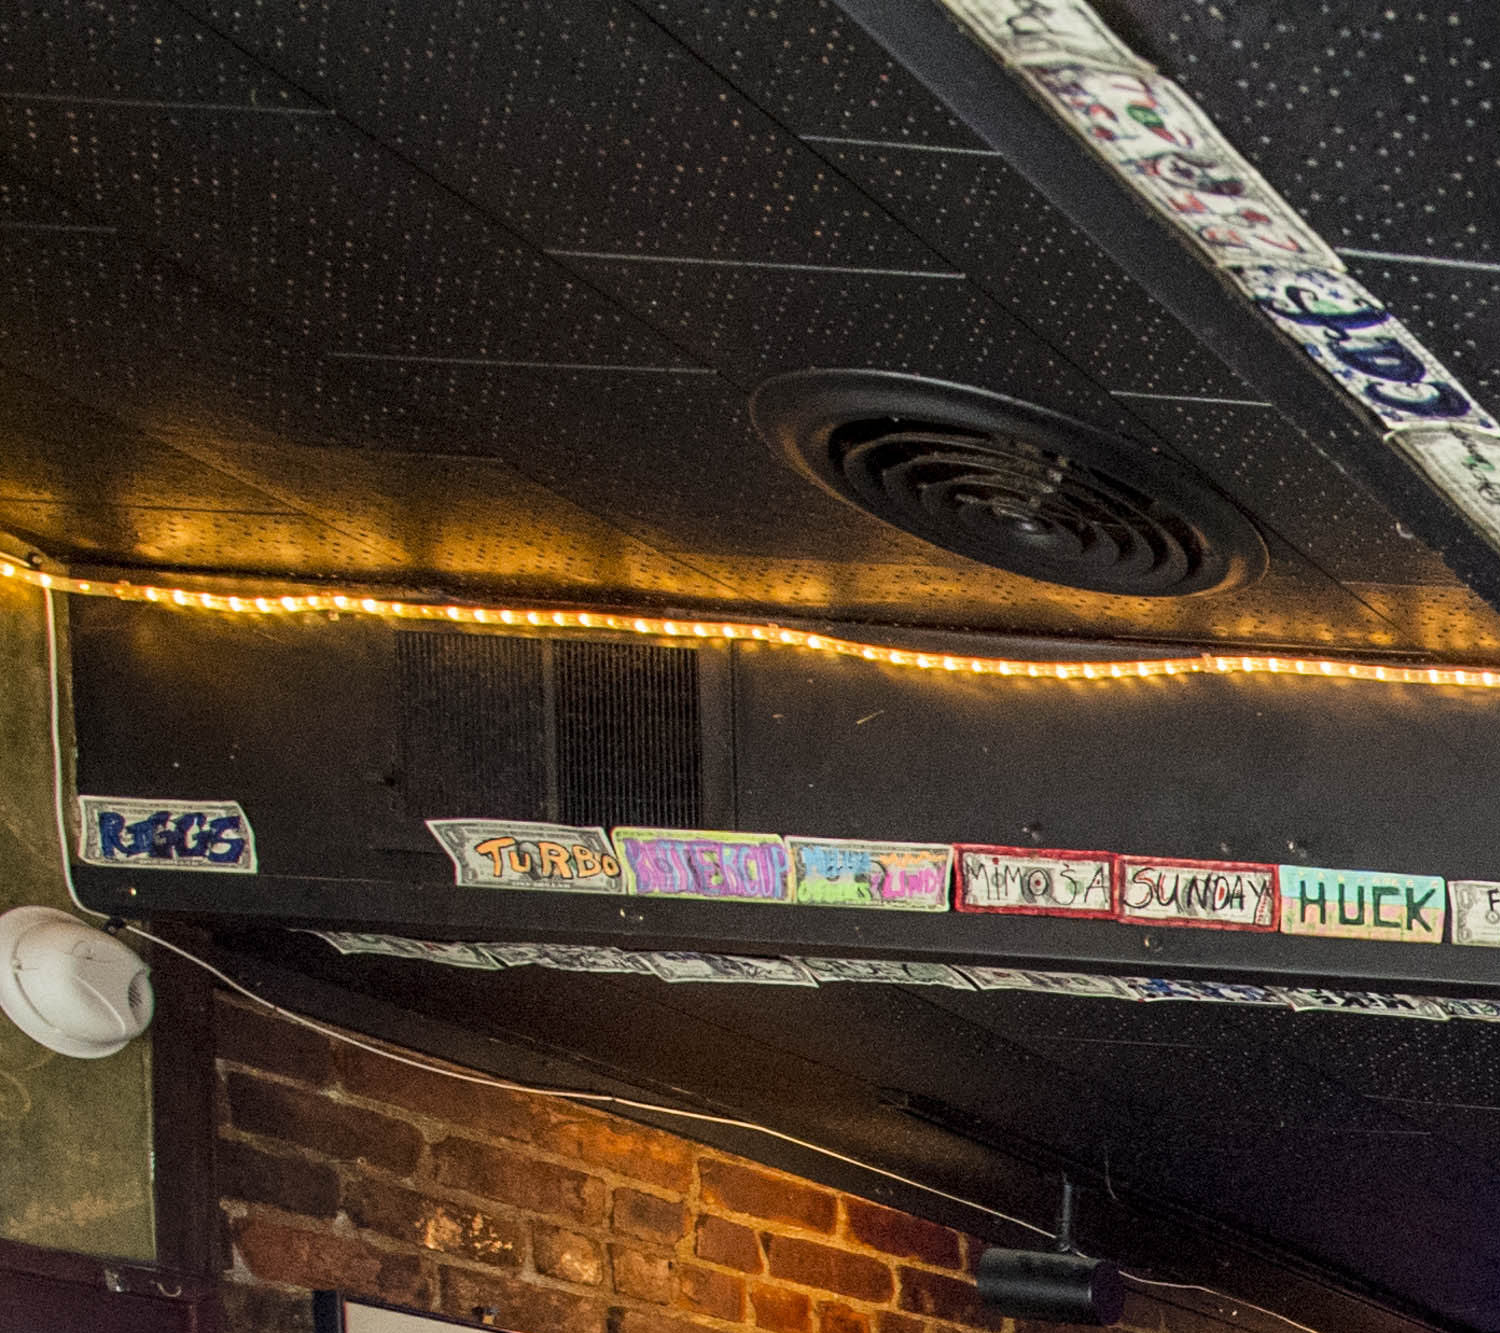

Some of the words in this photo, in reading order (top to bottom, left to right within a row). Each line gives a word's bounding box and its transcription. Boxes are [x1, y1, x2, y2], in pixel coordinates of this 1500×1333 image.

[97, 811, 246, 863] RIGGS
[476, 836, 621, 882] TURBO
[1130, 866, 1272, 926] SUNDAY
[1299, 875, 1437, 932] HUCK
